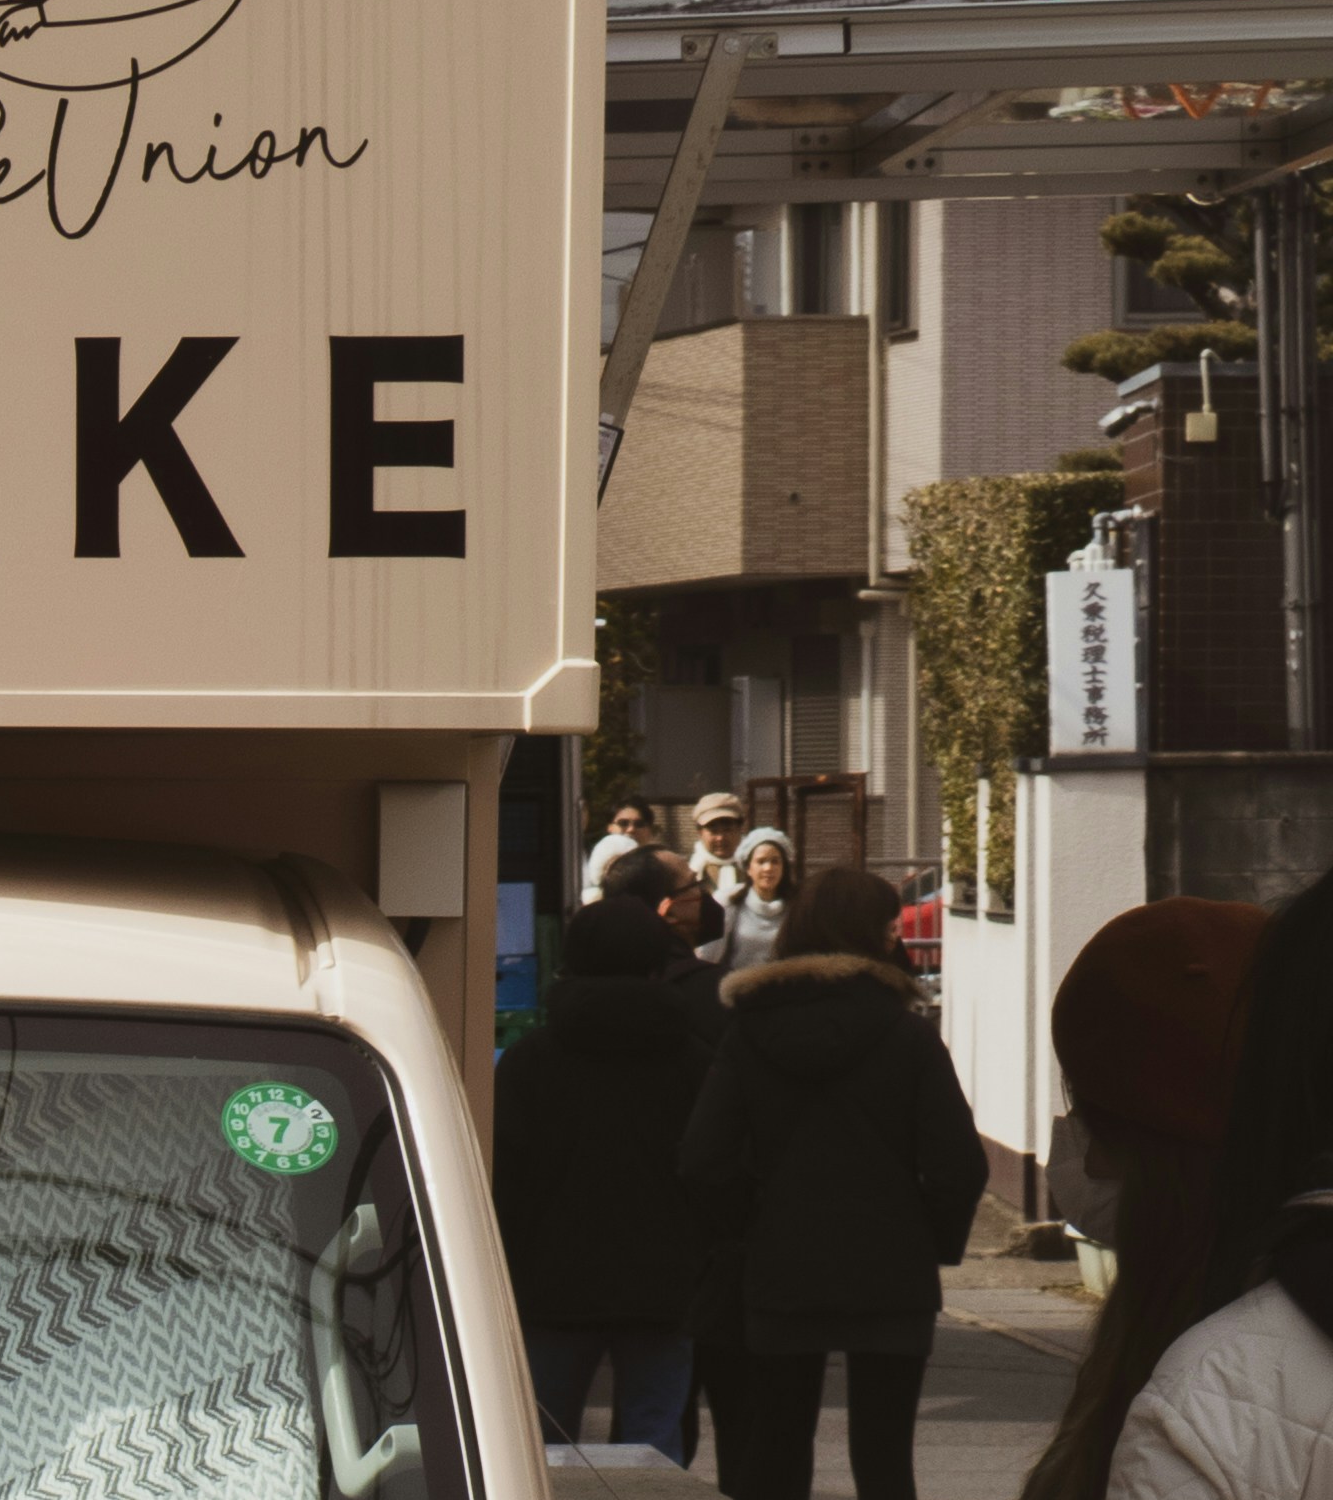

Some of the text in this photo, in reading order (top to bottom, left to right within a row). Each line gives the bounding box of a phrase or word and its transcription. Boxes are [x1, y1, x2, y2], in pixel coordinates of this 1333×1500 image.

[248, 1091, 263, 1103] 11
[268, 1088, 285, 1100] 12
[293, 1095, 302, 1107] 1
[233, 1103, 250, 1115] 10
[310, 1108, 324, 1120] 2
[230, 1118, 245, 1131] 9
[268, 1116, 291, 1144] 7
[316, 1125, 330, 1138] 3
[236, 1136, 251, 1150] 8
[311, 1143, 326, 1155] 4
[254, 1150, 269, 1163] 7
[276, 1156, 291, 1169] 6
[297, 1153, 311, 1166] 5
